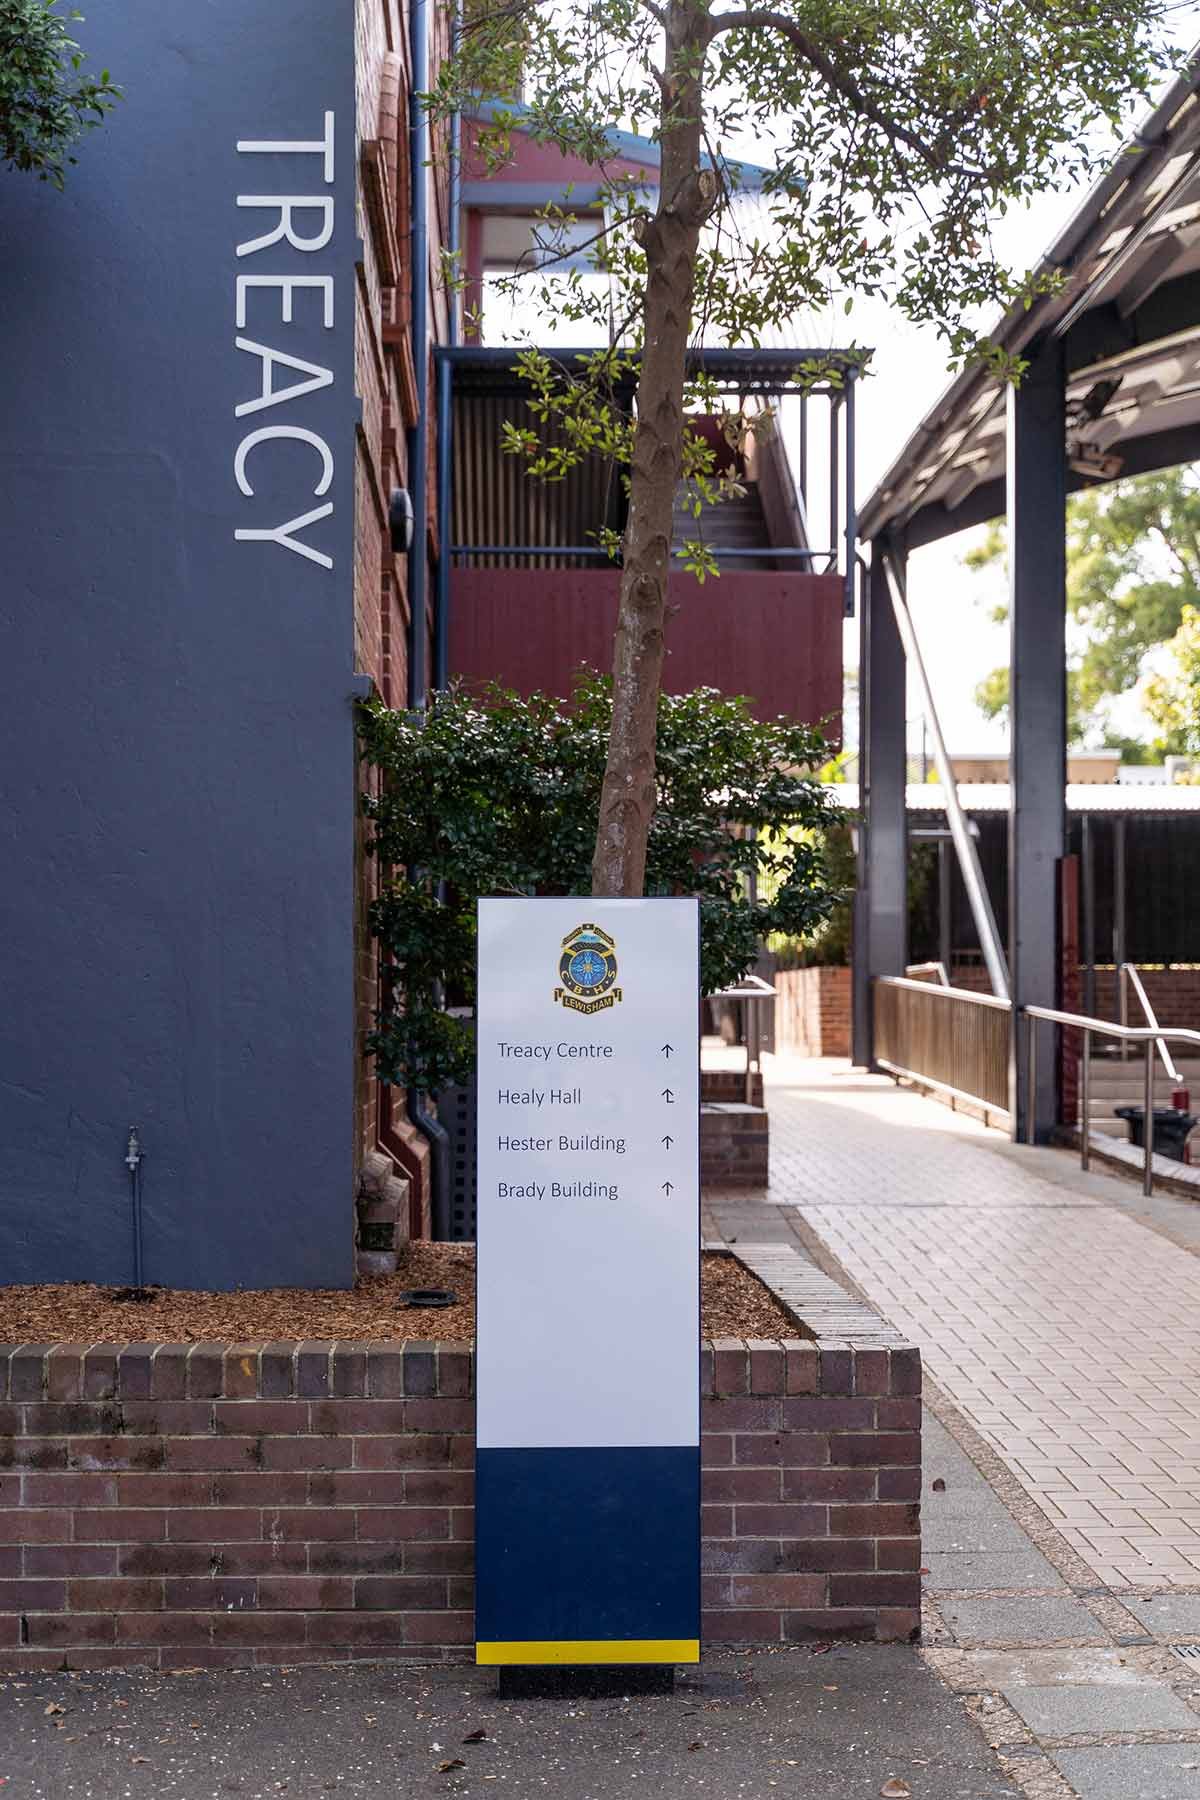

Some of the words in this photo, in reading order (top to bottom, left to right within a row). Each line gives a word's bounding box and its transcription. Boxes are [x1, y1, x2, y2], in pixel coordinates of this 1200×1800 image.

[234, 110, 335, 569] TREACY
[564, 997, 612, 1013] LEWISHAM
[497, 1042, 553, 1061] Treacy
[556, 1042, 613, 1058] Centre
[498, 1088, 545, 1108] Healy
[550, 1087, 581, 1105] Hall
[498, 1135, 553, 1151] Hester
[559, 1135, 626, 1154] Building
[498, 1181, 546, 1201] Brady
[551, 1181, 619, 1201] Building
